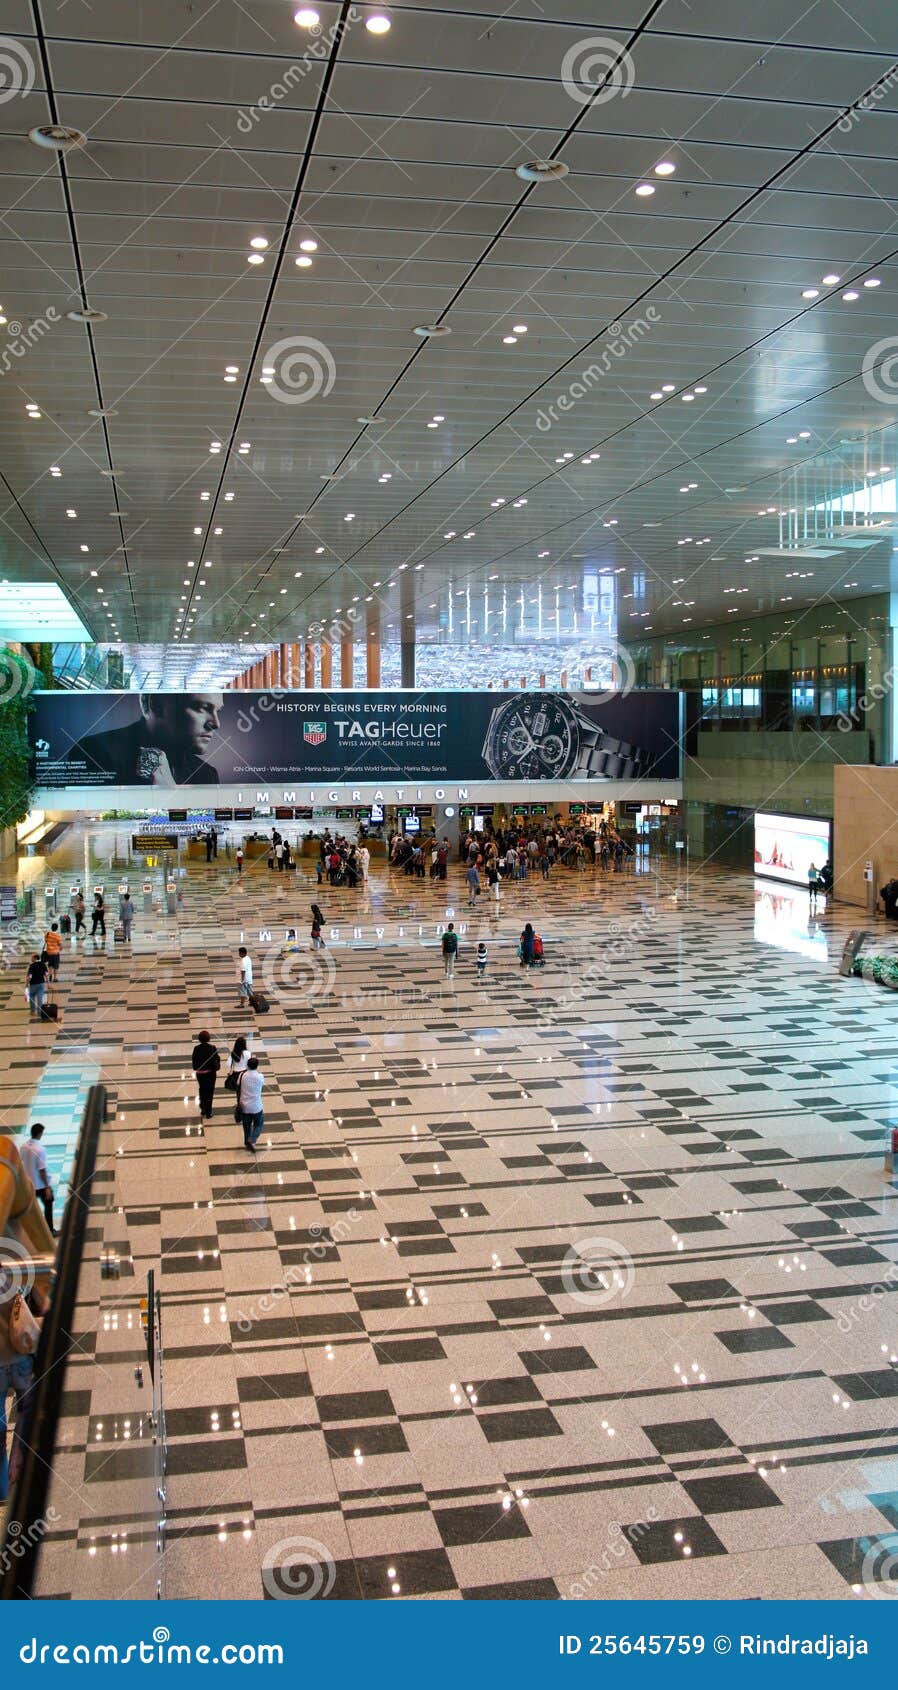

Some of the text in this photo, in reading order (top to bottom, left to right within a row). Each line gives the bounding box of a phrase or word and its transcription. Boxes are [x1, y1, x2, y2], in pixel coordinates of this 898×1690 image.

[277, 704, 447, 713] HISTORY BEGINS EVERY MORNING
[307, 724, 323, 733] TAG
[305, 733, 325, 745] HEUER
[238, 789, 468, 803] IMMIGRATION
